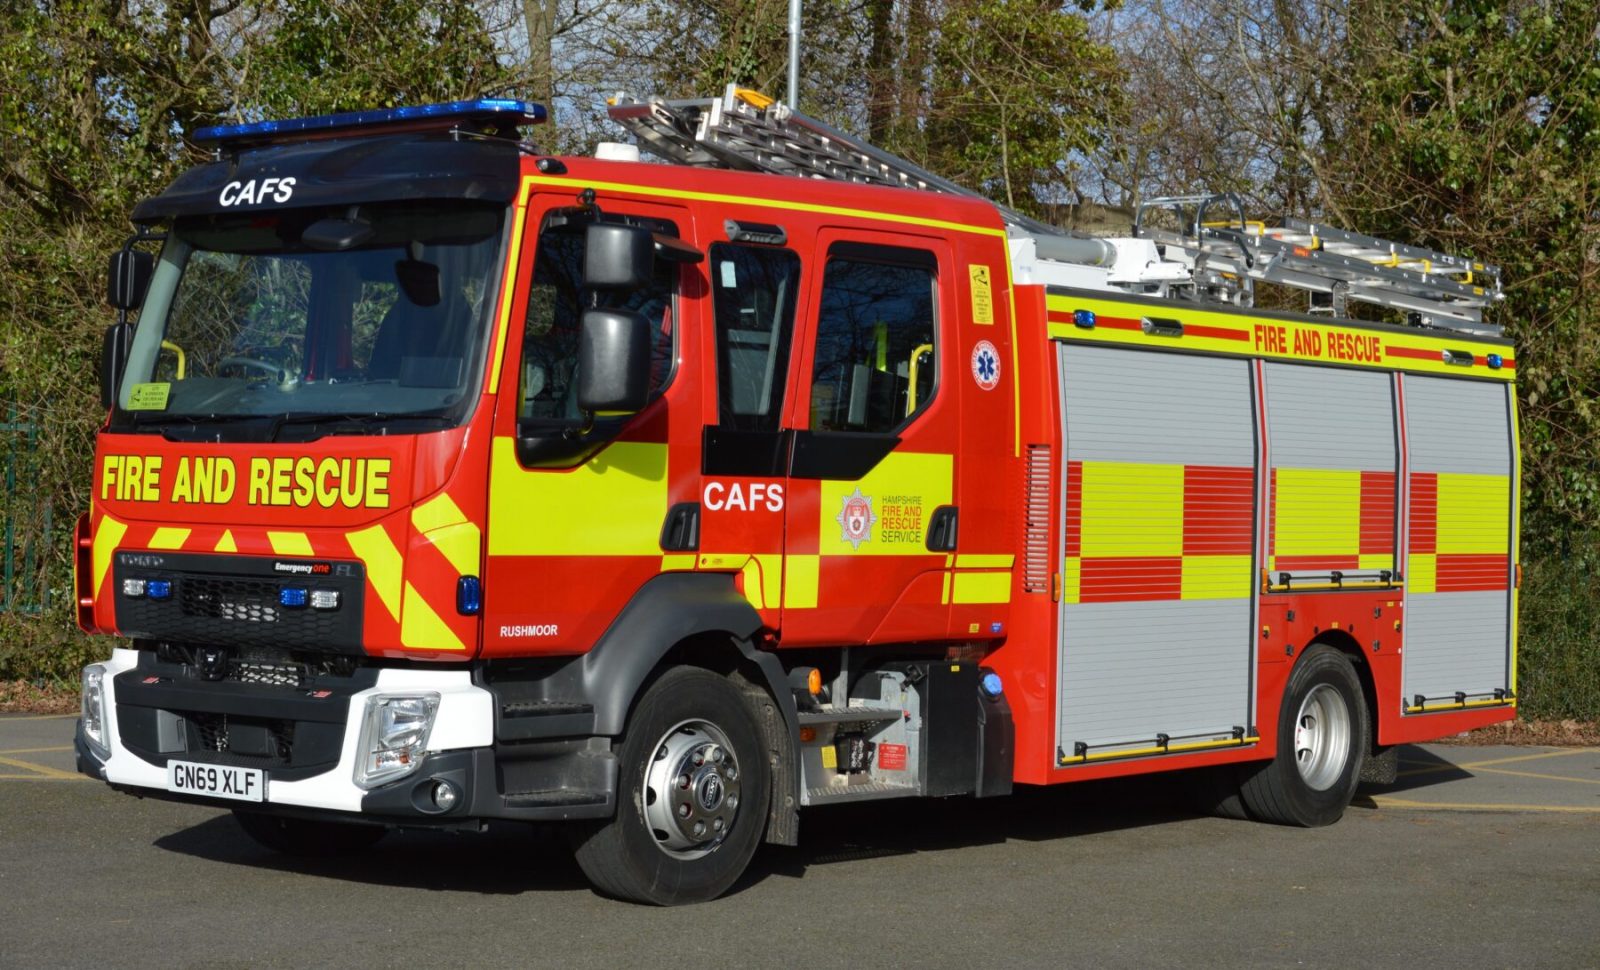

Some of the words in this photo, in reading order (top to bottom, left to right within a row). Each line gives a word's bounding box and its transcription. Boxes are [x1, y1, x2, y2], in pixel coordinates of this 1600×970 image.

[219, 177, 296, 207] CAFS
[1254, 324, 1287, 353] FIRE
[1294, 328, 1322, 357] AND
[1327, 332, 1381, 362] RESCUE
[101, 455, 163, 502] FIRE
[171, 456, 236, 504] AND
[248, 457, 391, 509] RESCUE
[703, 482, 784, 512] CAFS
[882, 495, 922, 505] HAMPSHIRE
[881, 505, 901, 517] FIRE
[904, 505, 922, 517] AND
[881, 517, 922, 530] RESCUE
[881, 530, 921, 543] SERVICE
[500, 624, 558, 637] RUSHMOOR
[175, 764, 217, 791] GN69
[222, 769, 255, 795] XLF
